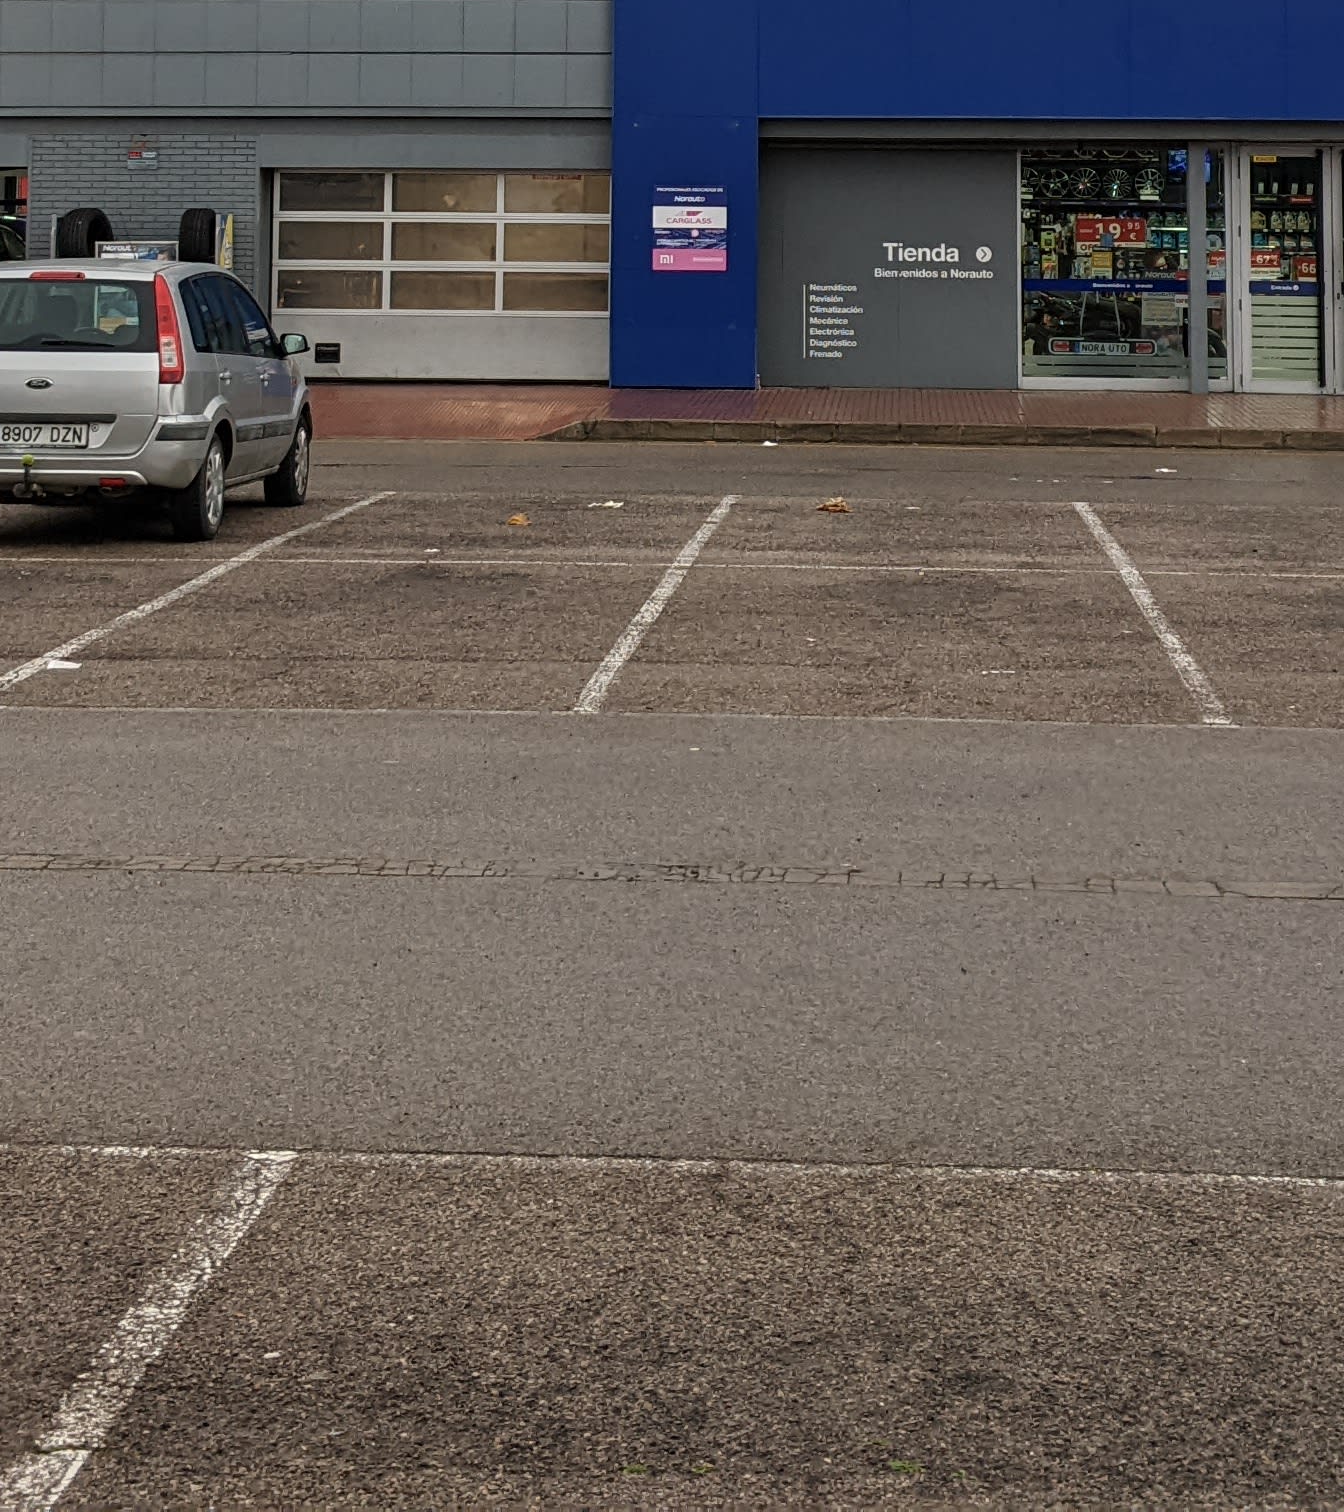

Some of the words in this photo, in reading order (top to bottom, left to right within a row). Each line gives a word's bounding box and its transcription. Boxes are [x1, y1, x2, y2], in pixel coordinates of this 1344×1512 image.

[883, 243, 959, 262] Tienda
[874, 268, 938, 278] Bienvenidos
[950, 269, 993, 279] Norauto
[810, 295, 843, 303] Revisión
[810, 306, 863, 314] Climatización
[810, 316, 848, 324] Mecánica
[810, 327, 854, 335] Electrónica
[810, 339, 857, 348] Diagnóstico
[1081, 343, 1106, 352] NORA
[810, 350, 843, 358] Frenado
[1, 426, 42, 442] 8907
[50, 427, 83, 443] DZN
